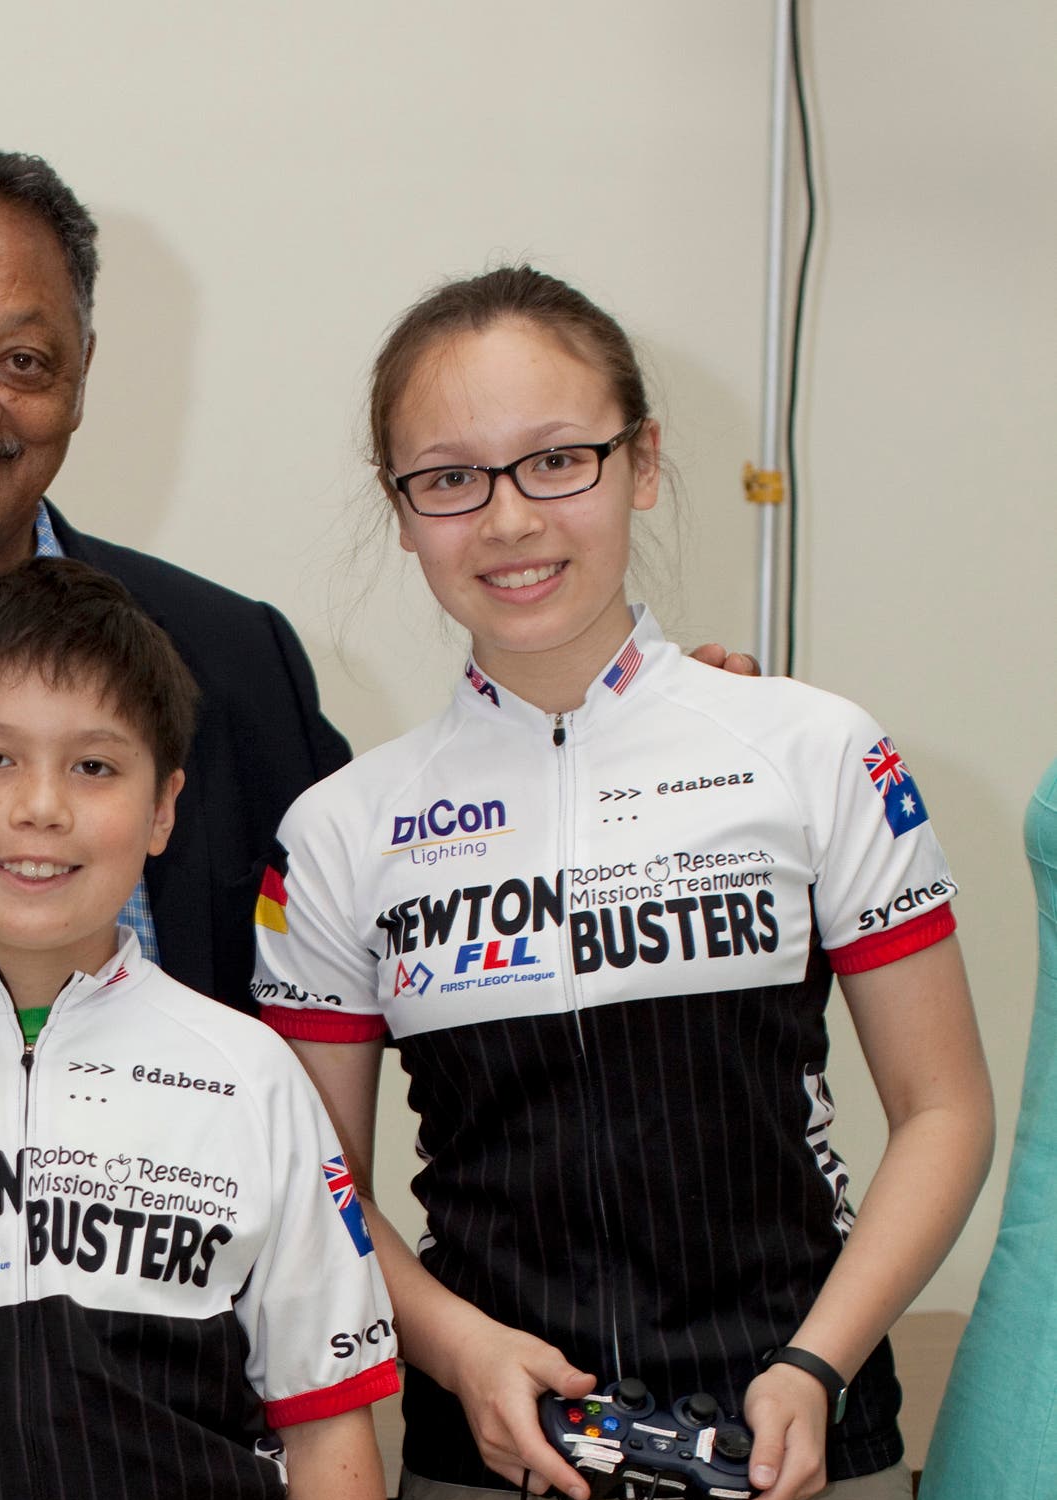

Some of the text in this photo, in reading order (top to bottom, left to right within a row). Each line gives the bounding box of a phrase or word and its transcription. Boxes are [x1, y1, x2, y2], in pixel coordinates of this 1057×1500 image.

[656, 772, 754, 795] @dabeaz
[391, 799, 506, 845] DiCon
[411, 841, 487, 865] Lighting
[568, 850, 775, 887] Robot Research
[570, 871, 773, 910] Missions Teamwork
[376, 868, 780, 976] NEWTON BUSTERS
[454, 936, 538, 975] FLL
[514, 971, 555, 983] League
[132, 1064, 237, 1097] @dabeaz
[25, 1146, 239, 1199] Robot Research
[28, 1173, 238, 1224] Missions Teamwork
[25, 1197, 234, 1288] BUSTERS
